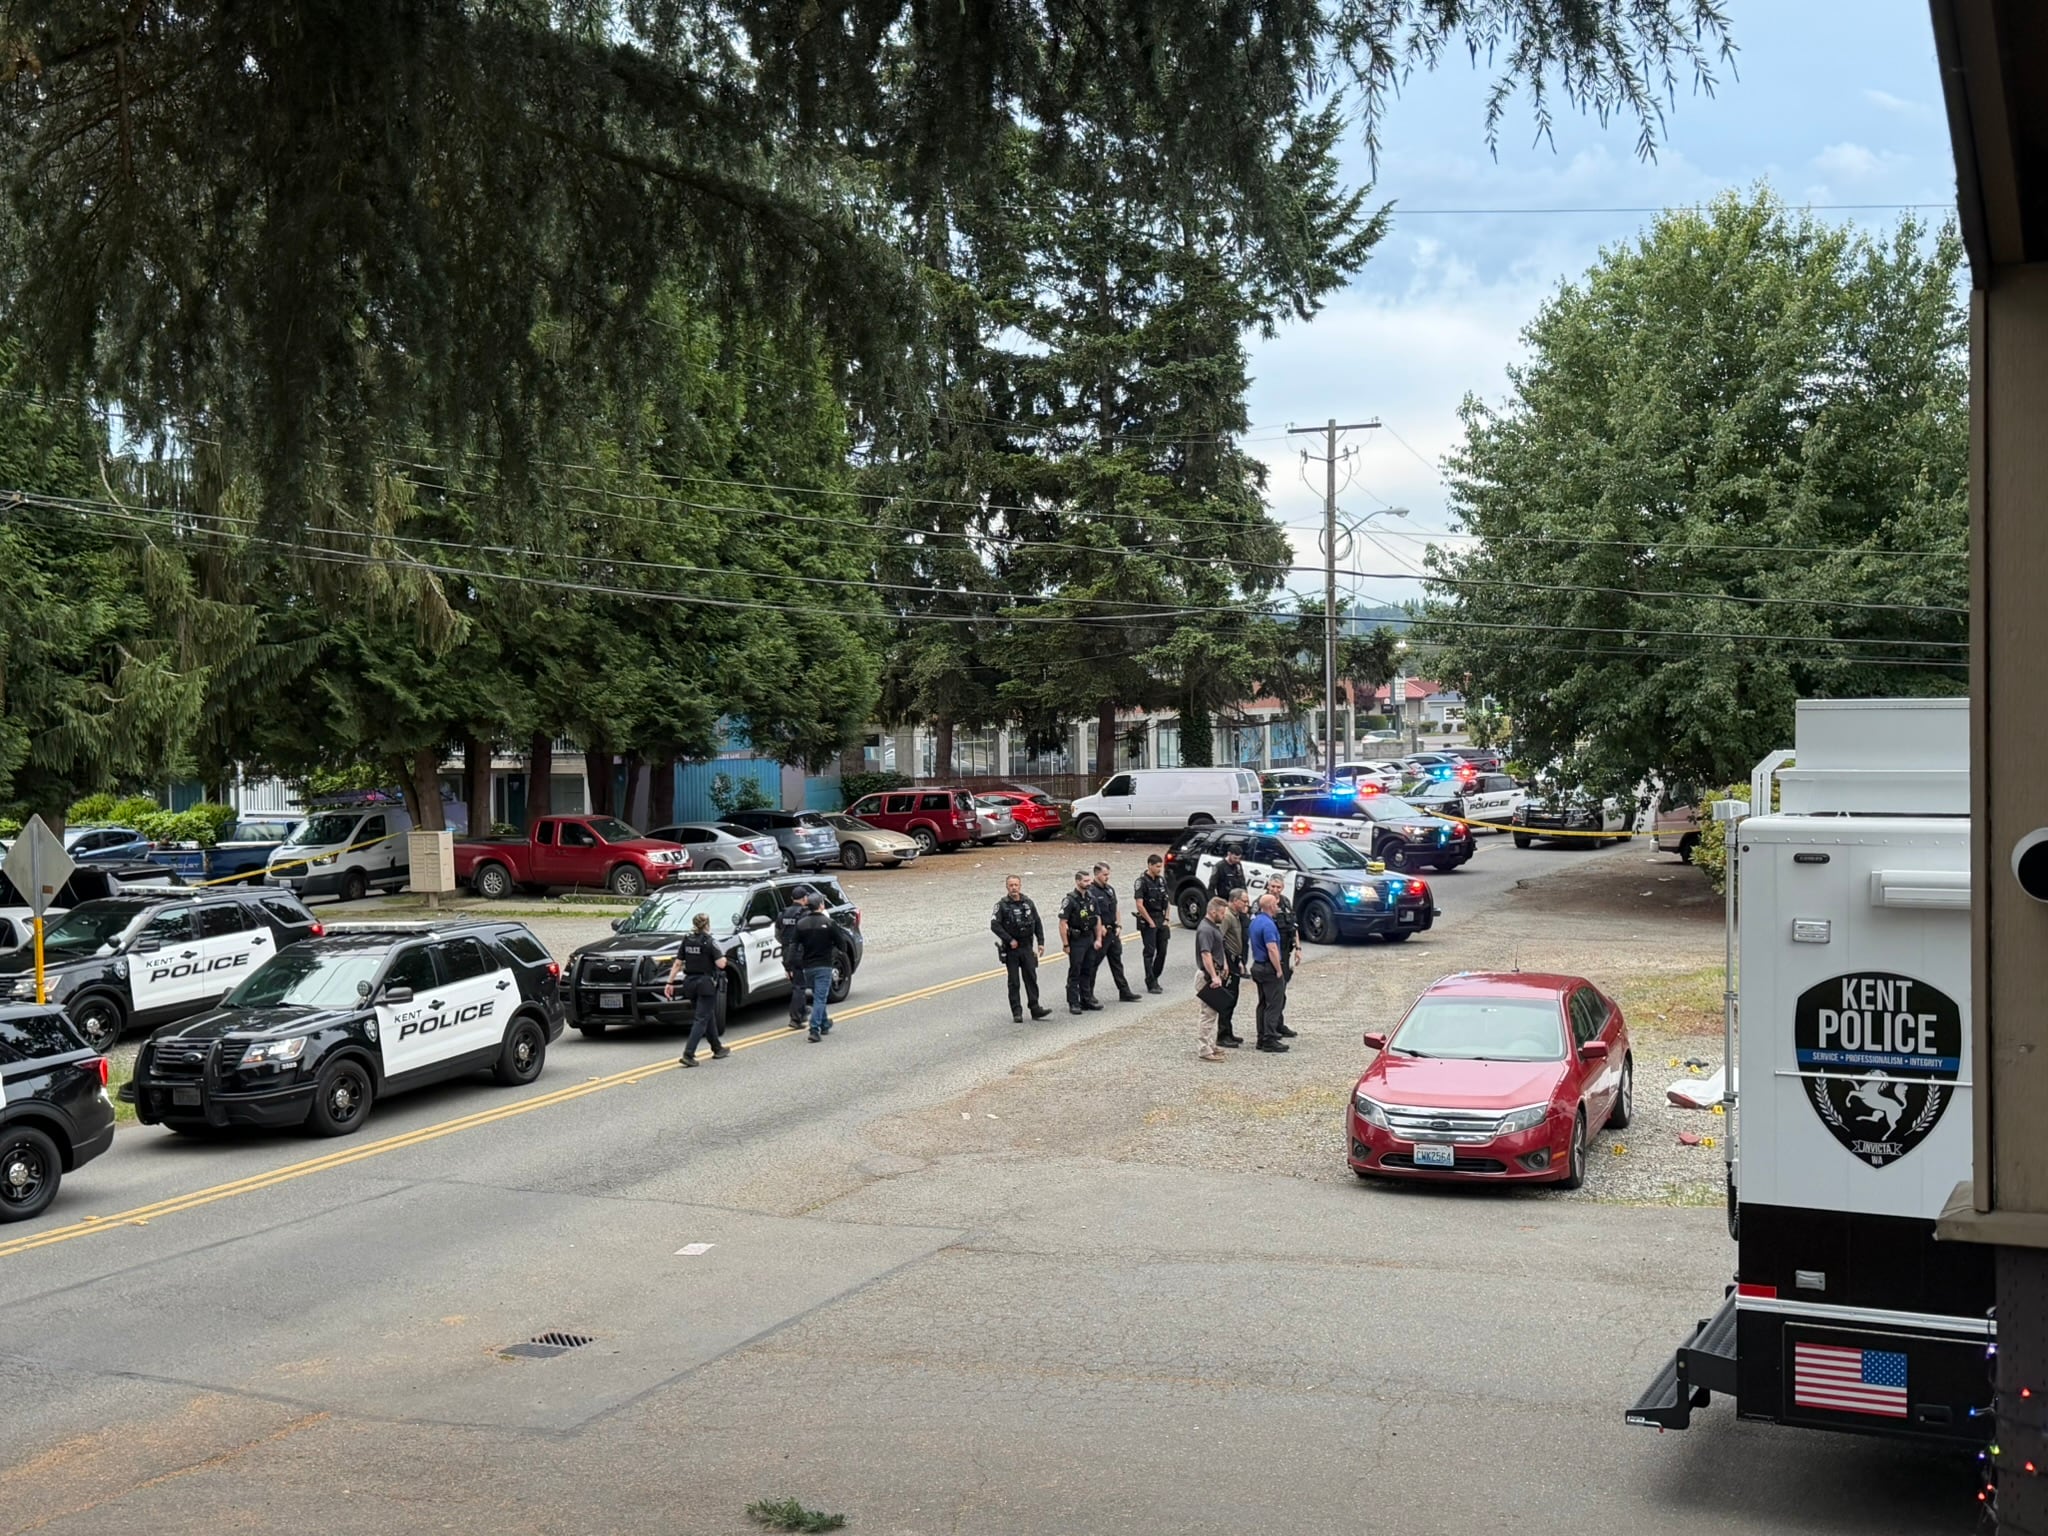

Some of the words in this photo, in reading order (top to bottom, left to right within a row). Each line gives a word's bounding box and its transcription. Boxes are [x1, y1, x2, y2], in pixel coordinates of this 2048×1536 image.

[1469, 800, 1510, 811] POLICE
[685, 946, 701, 954] POLICE
[756, 939, 774, 949] KENT
[146, 957, 175, 968] KENT
[150, 953, 250, 983] POLICE
[1842, 978, 1913, 1012] KENT
[394, 1009, 422, 1023] KENT
[398, 1000, 495, 1042] POLICE
[1818, 1008, 1938, 1055] POLICE
[1812, 1052, 1839, 1061] SERVICE
[1845, 1054, 1903, 1065] PROFESSIONALISM
[1909, 1057, 1943, 1067] INTEGRITY
[1862, 1142, 1891, 1153] INVICTA
